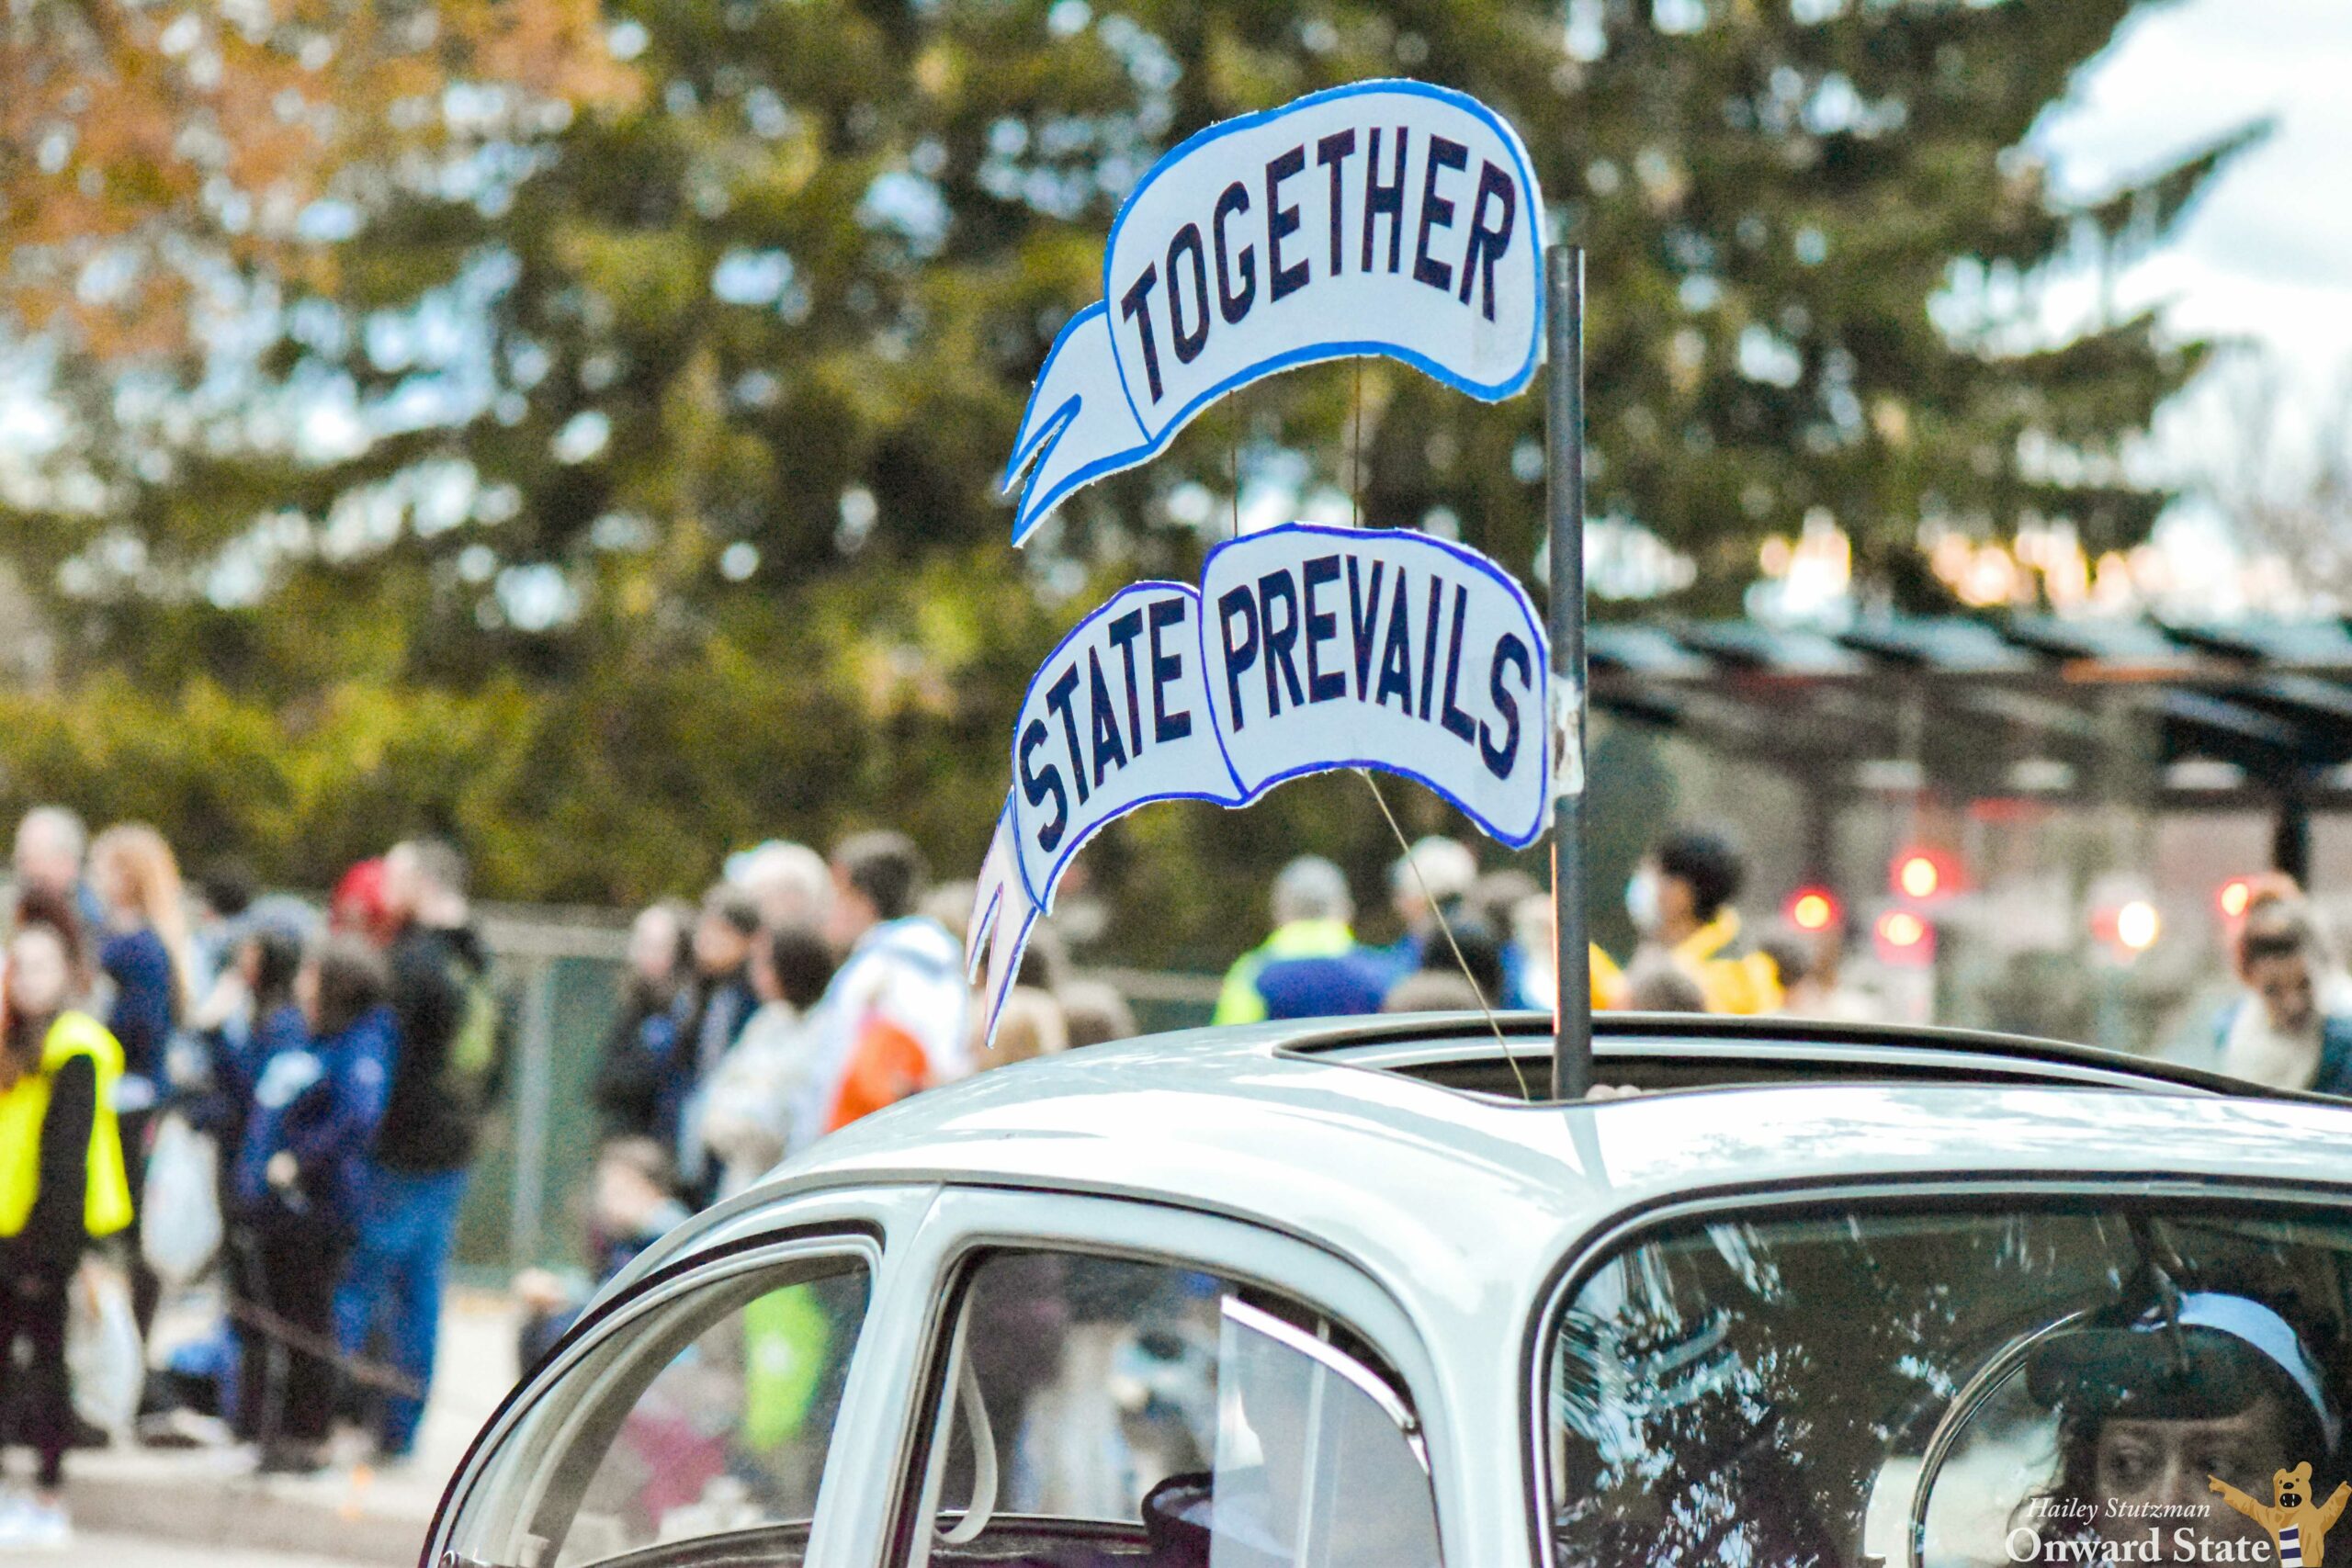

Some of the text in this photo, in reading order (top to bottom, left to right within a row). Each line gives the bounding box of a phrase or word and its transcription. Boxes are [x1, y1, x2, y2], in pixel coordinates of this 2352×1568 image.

[1120, 125, 1517, 406] TOGETHER
[1018, 553, 1532, 853] STATE PREVAILS
